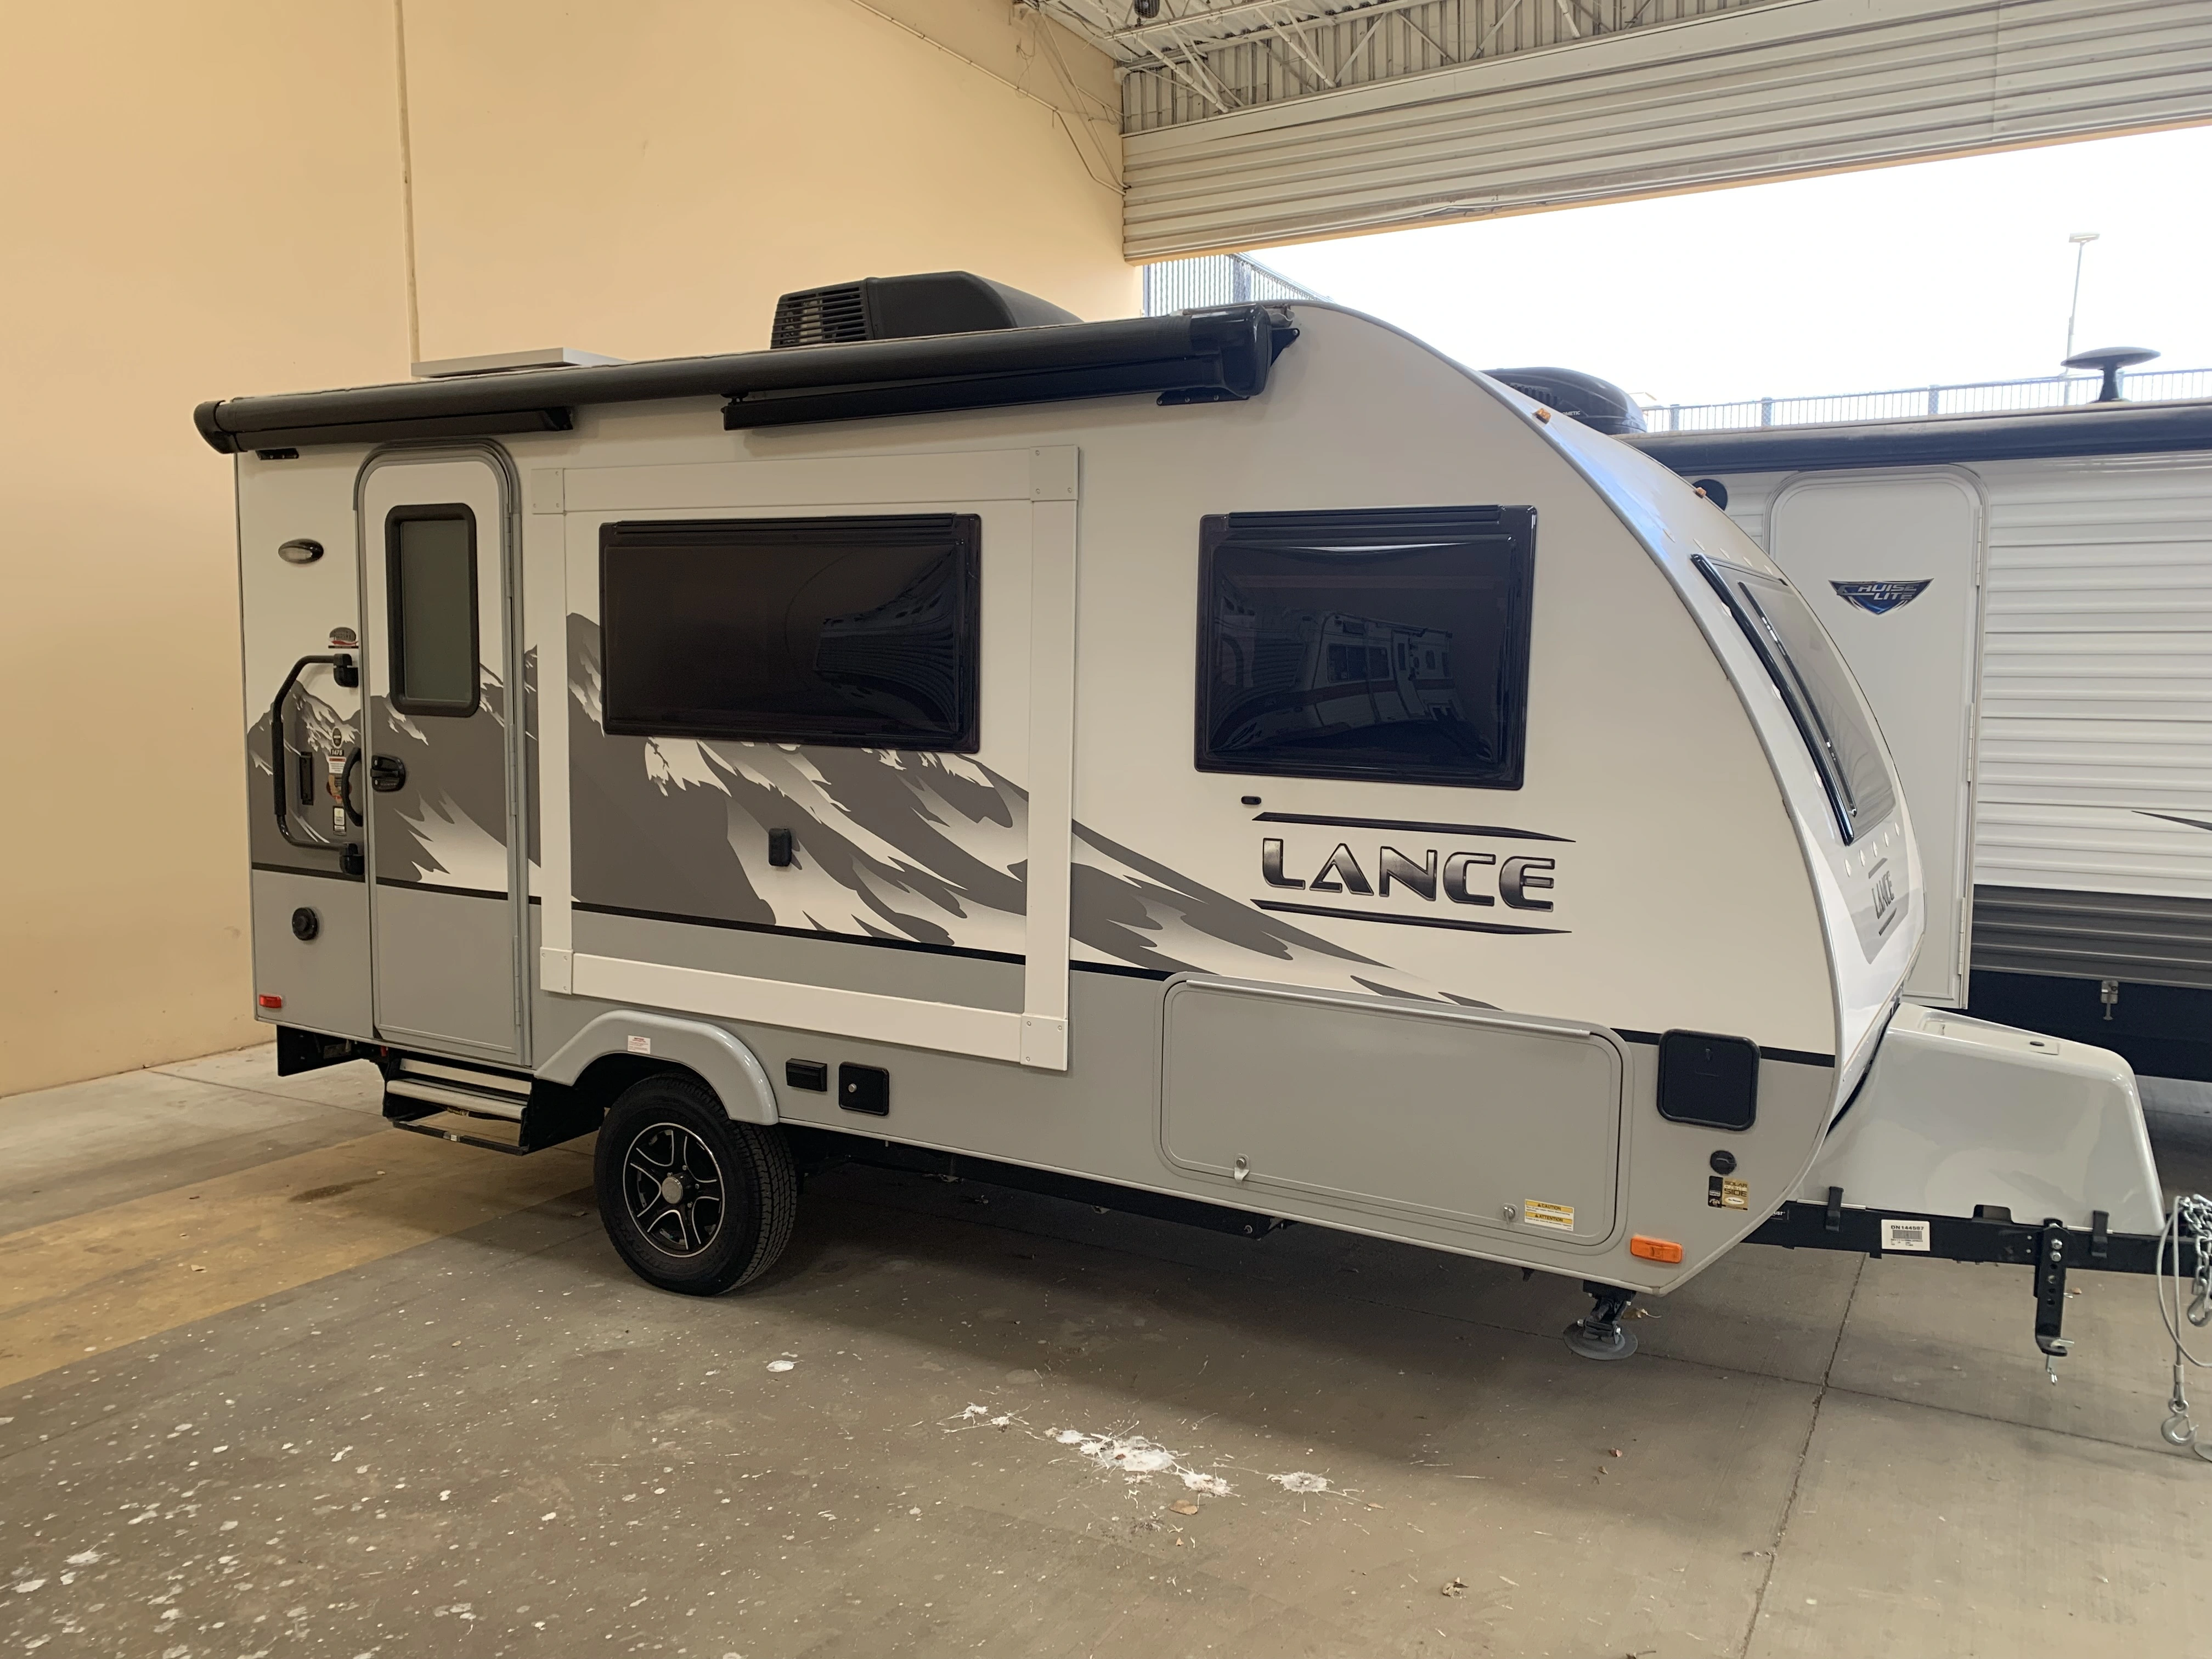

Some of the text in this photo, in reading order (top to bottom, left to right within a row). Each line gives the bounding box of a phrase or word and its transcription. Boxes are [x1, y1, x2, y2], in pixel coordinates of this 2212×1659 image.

[1837, 584, 1919, 595] CRUISE
[1262, 838, 1555, 912] LANCE
[1871, 870, 1894, 919] LANCE
[1724, 1188, 1747, 1197] SIDE
[1539, 1214, 1563, 1222] ATTENTION
